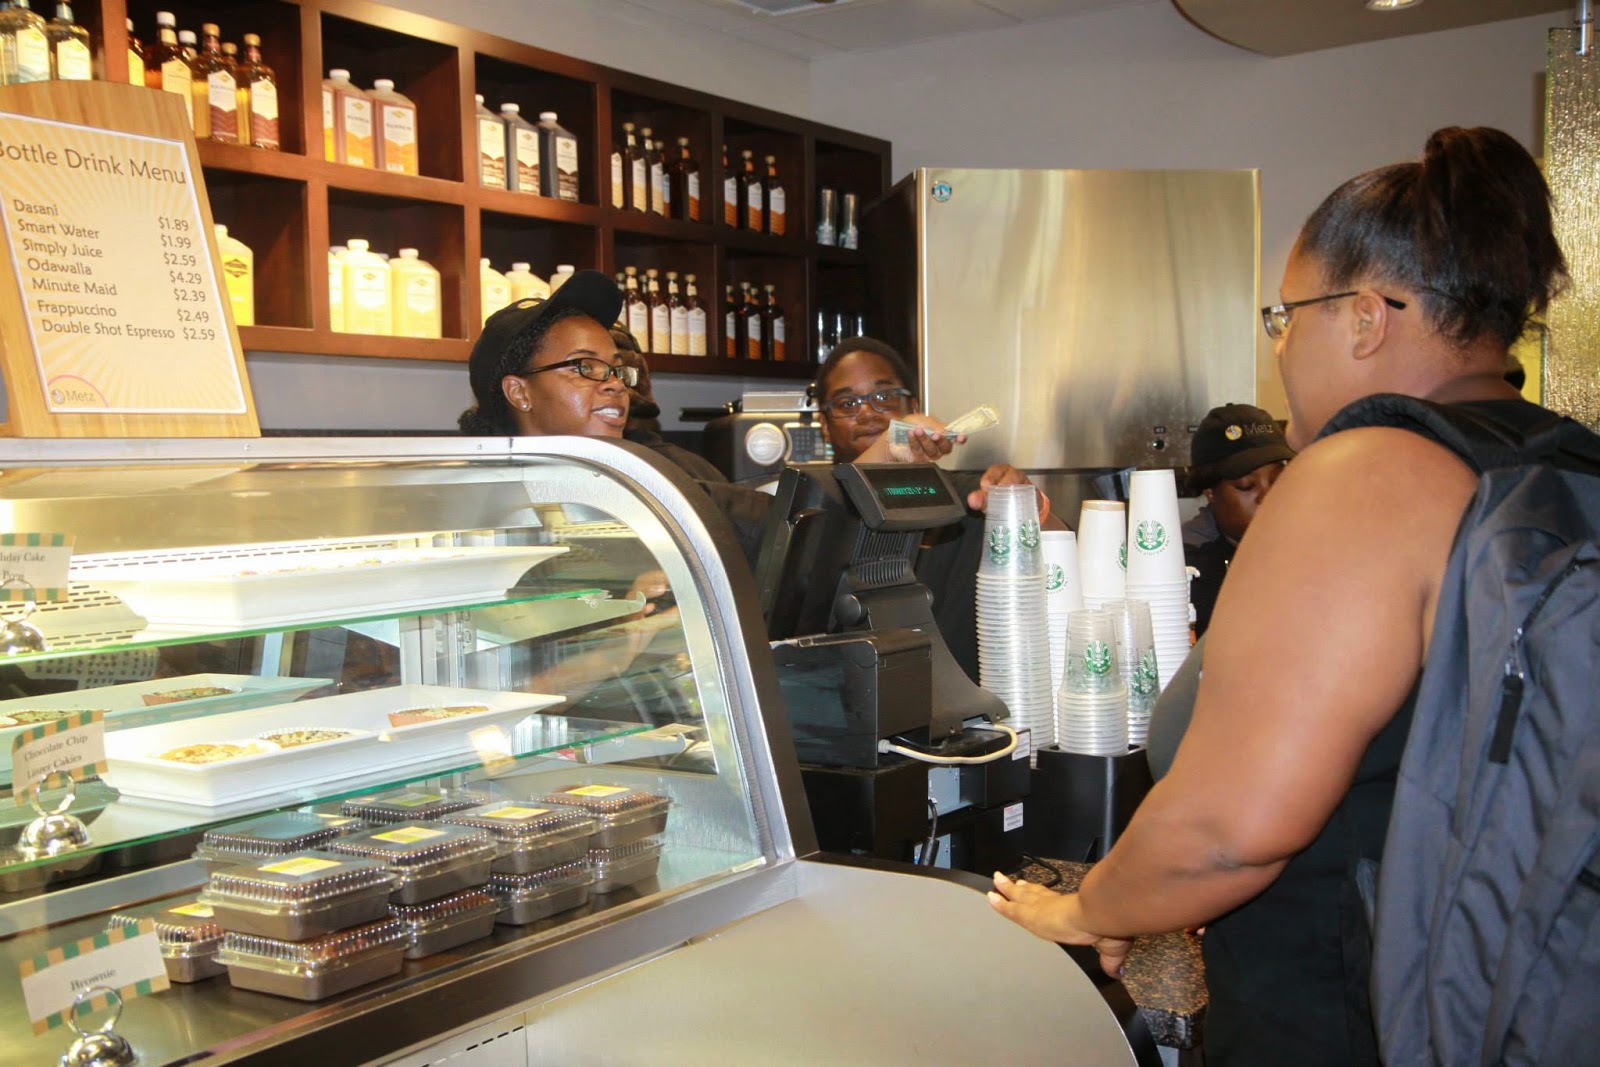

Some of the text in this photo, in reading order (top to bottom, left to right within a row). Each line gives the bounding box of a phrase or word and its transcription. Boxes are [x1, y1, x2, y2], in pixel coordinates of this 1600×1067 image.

[65, 148, 124, 176] Drink
[129, 158, 187, 185] Menu
[13, 199, 189, 232] Dasani $1.89
[18, 218, 191, 249] Smart Water $1.99
[23, 238, 196, 267] Simply Juice $2.59
[27, 257, 202, 285] Odawalla $4.29
[31, 277, 206, 302] Minute Maid $2.39
[37, 300, 209, 323] Frappuccino $2.49
[41, 319, 216, 341] Double Shot Espresso $2.59
[65, 390, 97, 402] Metz
[23, 552, 46, 561] Cake
[24, 735, 88, 762] Chocolate Chip
[70, 969, 117, 991] Brownie
